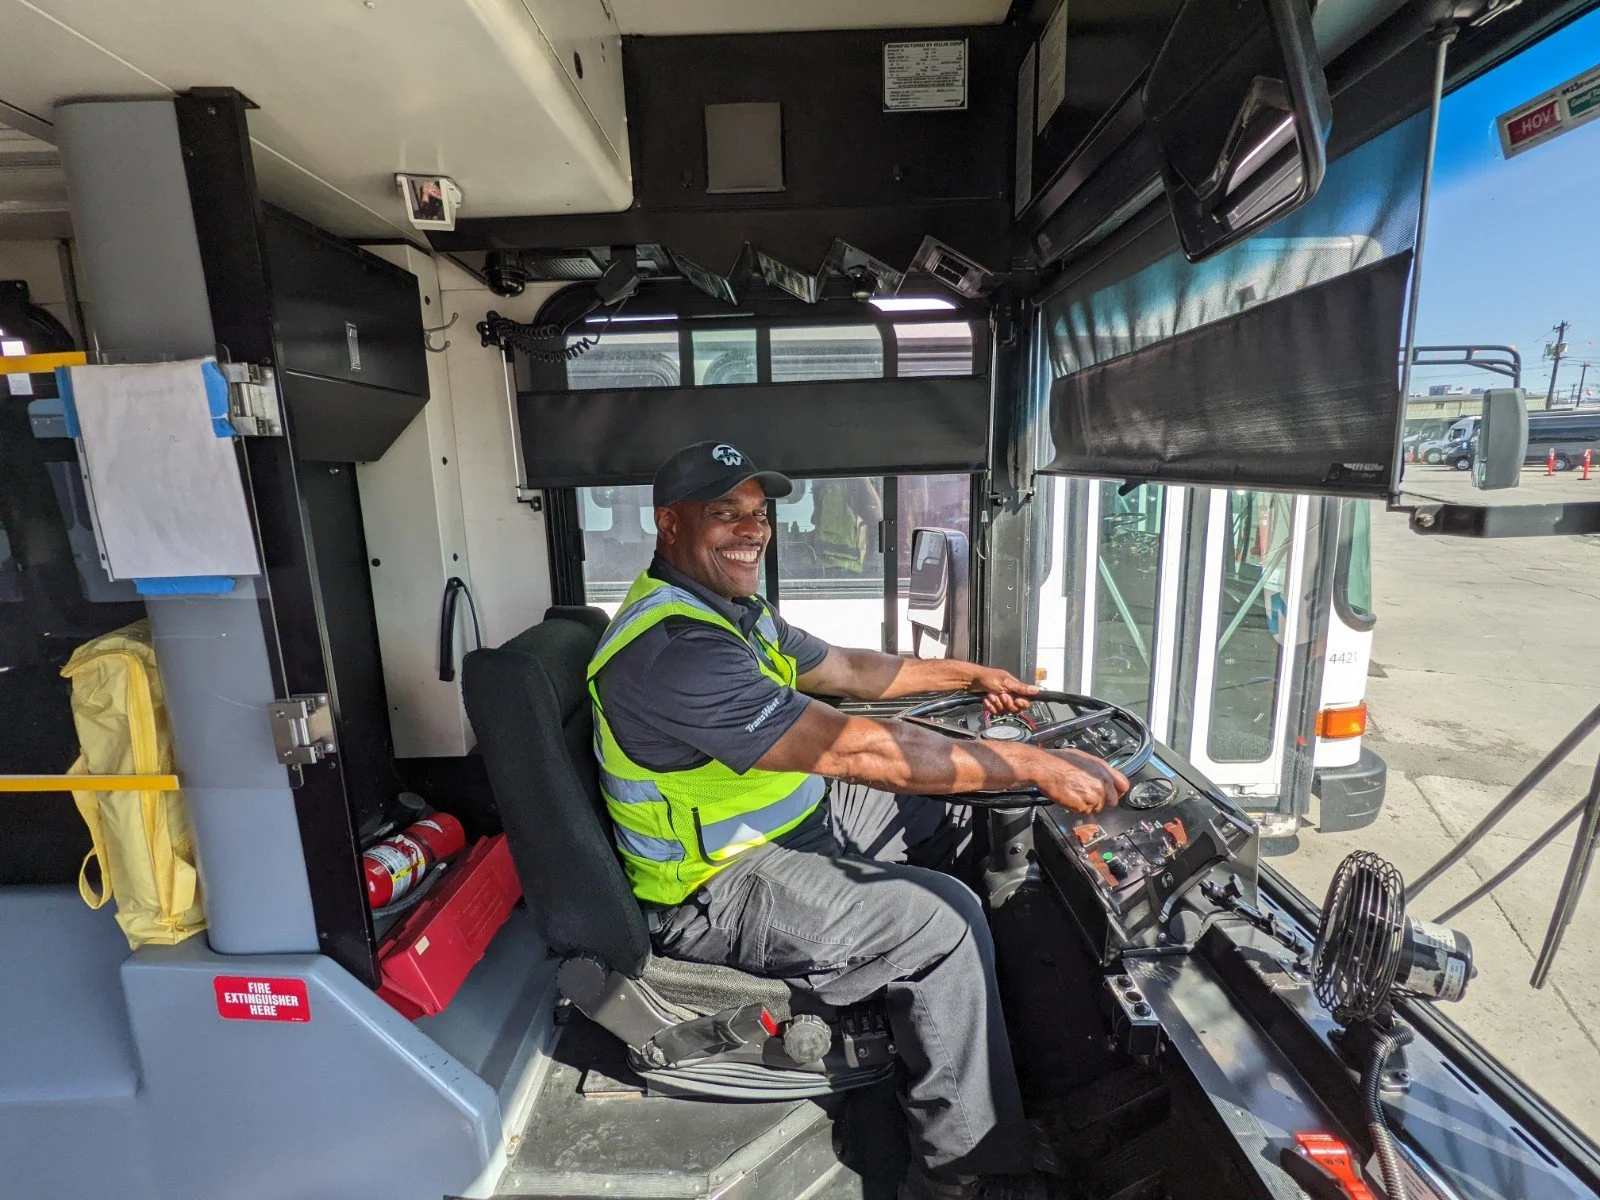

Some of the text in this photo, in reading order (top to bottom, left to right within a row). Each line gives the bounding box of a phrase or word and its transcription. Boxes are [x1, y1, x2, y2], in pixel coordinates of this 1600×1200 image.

[1521, 108, 1551, 134] HOV
[745, 698, 780, 733] TransWest
[247, 982, 272, 993] FIRE
[224, 992, 299, 1007] EXTINGUISHER
[250, 1005, 277, 1016] HERE
